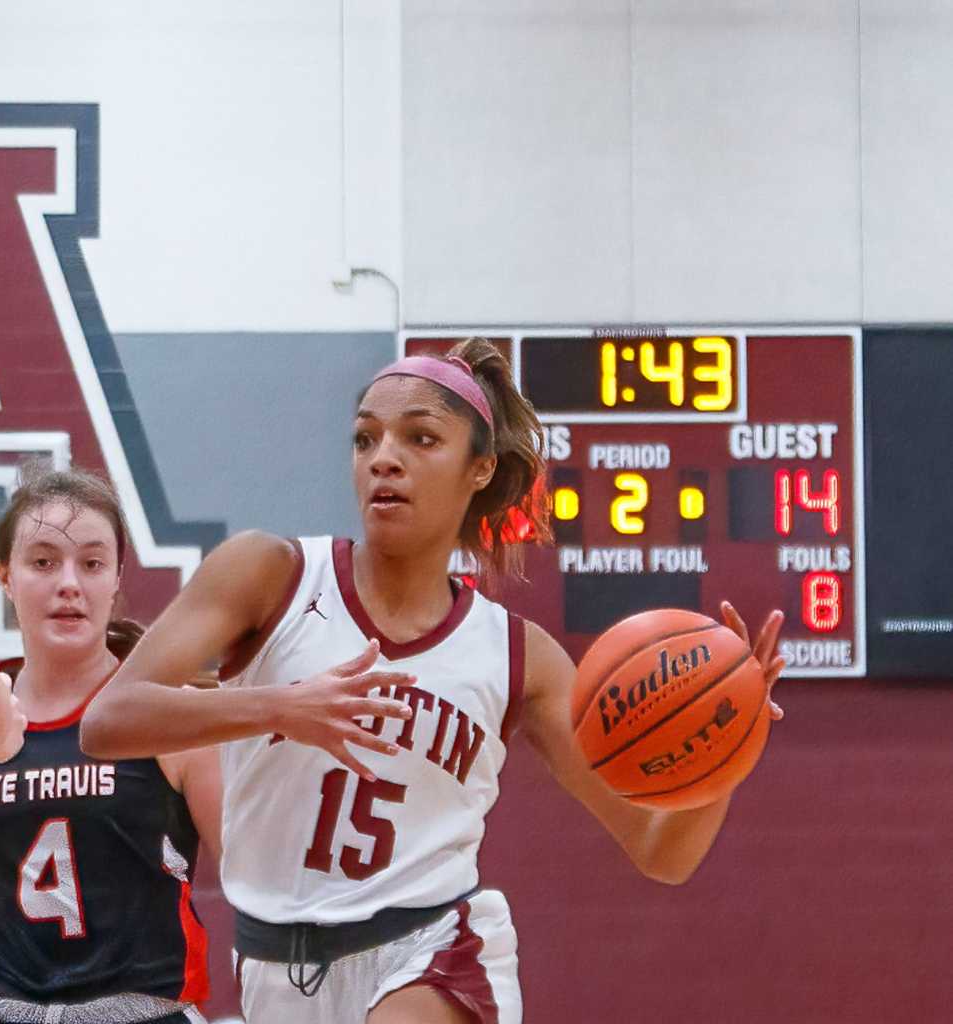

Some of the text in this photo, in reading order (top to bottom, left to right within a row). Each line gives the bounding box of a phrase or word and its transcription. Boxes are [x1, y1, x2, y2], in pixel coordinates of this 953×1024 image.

[601, 337, 732, 411] 1:43
[589, 443, 671, 470] PERIOD
[730, 423, 839, 460] GUEST
[610, 472, 648, 534] 2
[775, 468, 840, 537] 14
[559, 548, 708, 573] PLAYER FOUL
[779, 546, 851, 572] FOULS
[803, 571, 842, 633] 8
[780, 640, 852, 667] SCORE
[599, 644, 711, 736] Baden
[25, 765, 116, 799] TRAVIS
[304, 767, 407, 881] 15
[19, 817, 86, 938] 4
